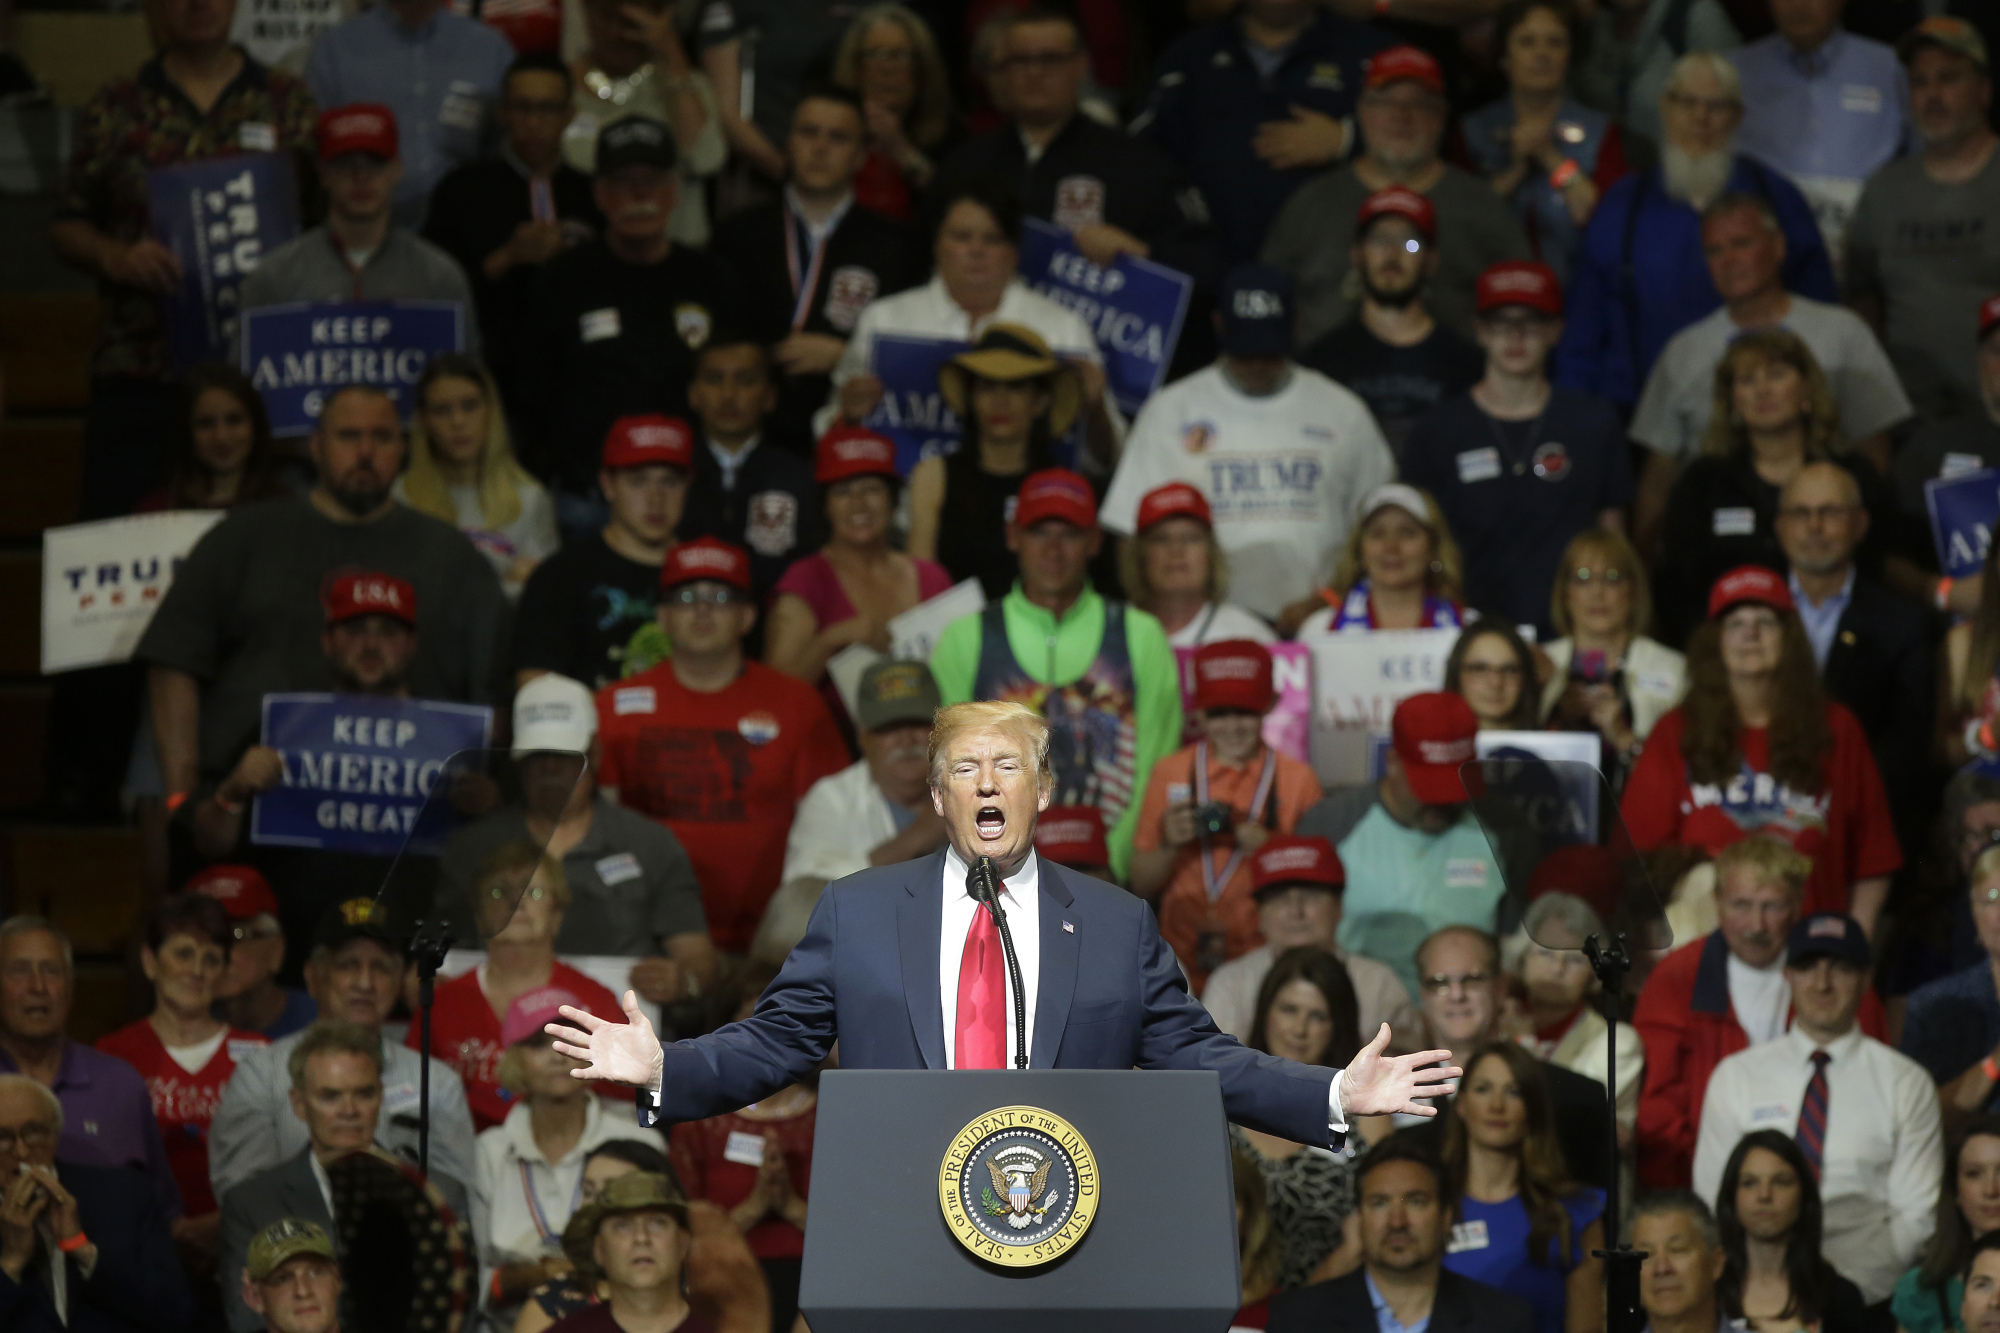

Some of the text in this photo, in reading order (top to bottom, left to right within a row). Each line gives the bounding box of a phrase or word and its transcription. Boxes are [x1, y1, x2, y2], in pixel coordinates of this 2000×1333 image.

[224, 169, 262, 274] TRU
[1047, 248, 1126, 297] KEEP
[311, 315, 392, 344] KEEP
[252, 347, 427, 391] AMERIC
[1210, 459, 1321, 494] TRUMP
[65, 556, 180, 590] TRU
[353, 581, 401, 609] USA
[1379, 655, 1436, 682] KEE
[333, 715, 417, 749] KEEP
[278, 749, 444, 798] AMERIC
[316, 799, 420, 835] GREAT
[944, 1112, 1094, 1260] SEAL OF THE PRESIDENT OF THE UNITED STATES
